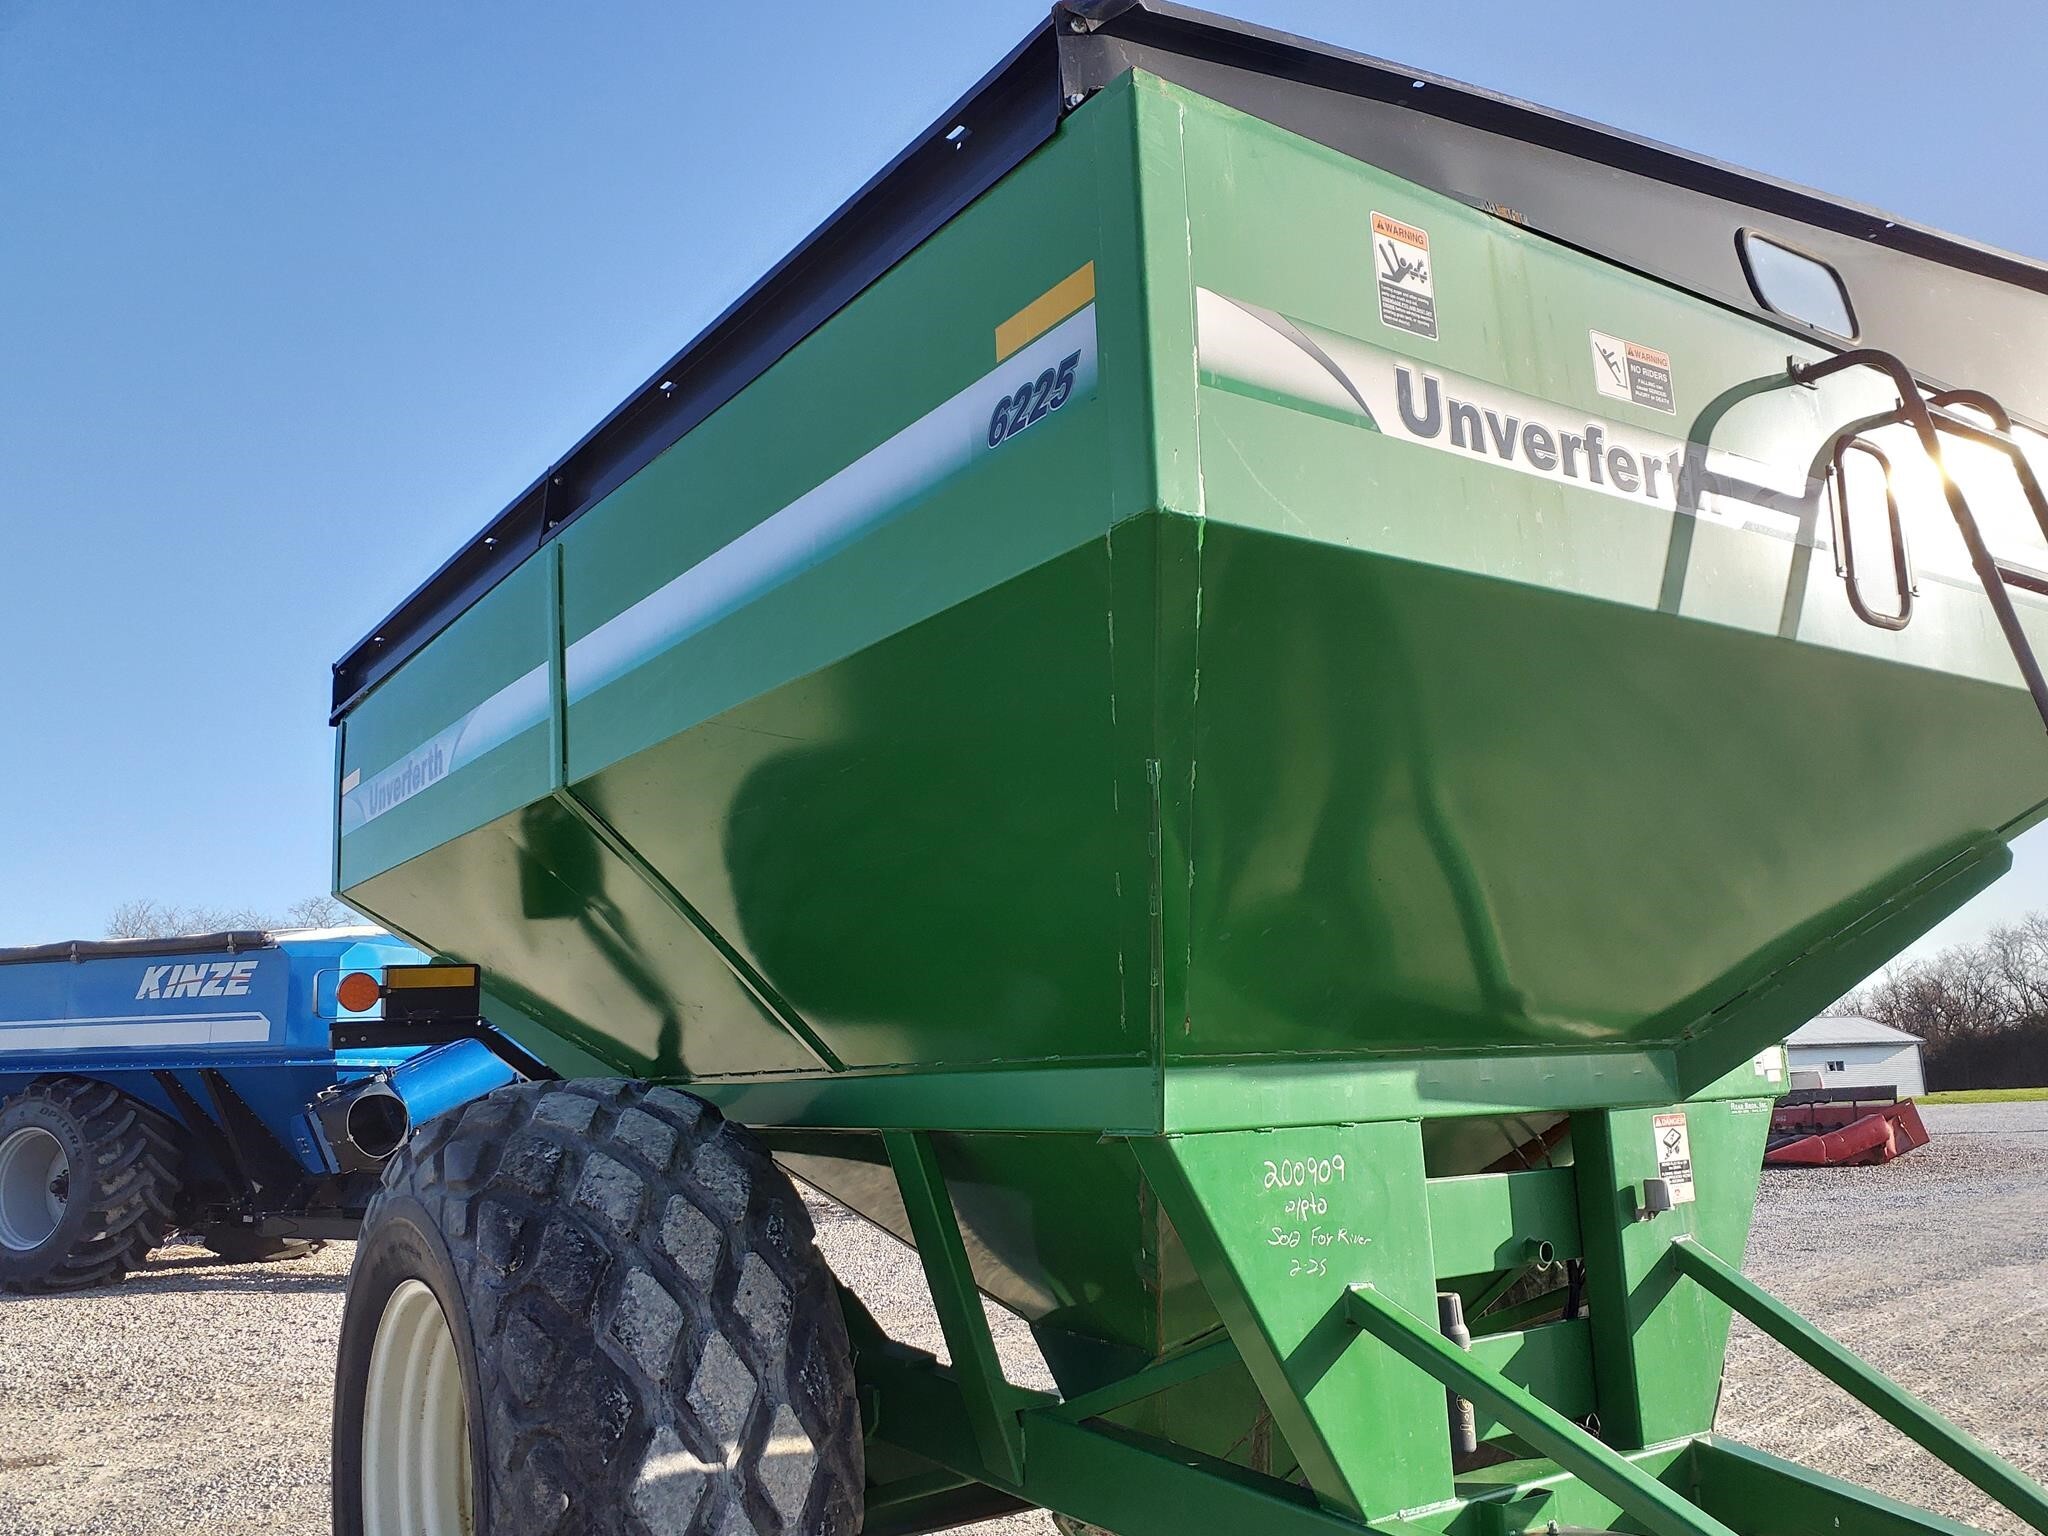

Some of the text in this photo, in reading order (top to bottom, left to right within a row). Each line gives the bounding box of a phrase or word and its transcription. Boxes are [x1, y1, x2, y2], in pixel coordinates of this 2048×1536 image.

[1384, 221, 1424, 245] WARNING
[1630, 363, 1668, 383] NO RIDERS
[1634, 348, 1668, 367] WARNING
[987, 348, 1081, 449] 6225
[1393, 363, 1723, 515] Unverferth
[369, 743, 445, 816] Unverferth
[135, 960, 259, 1000] KINZE
[1263, 1154, 1345, 1189] 200909
[1337, 1227, 1373, 1246] River
